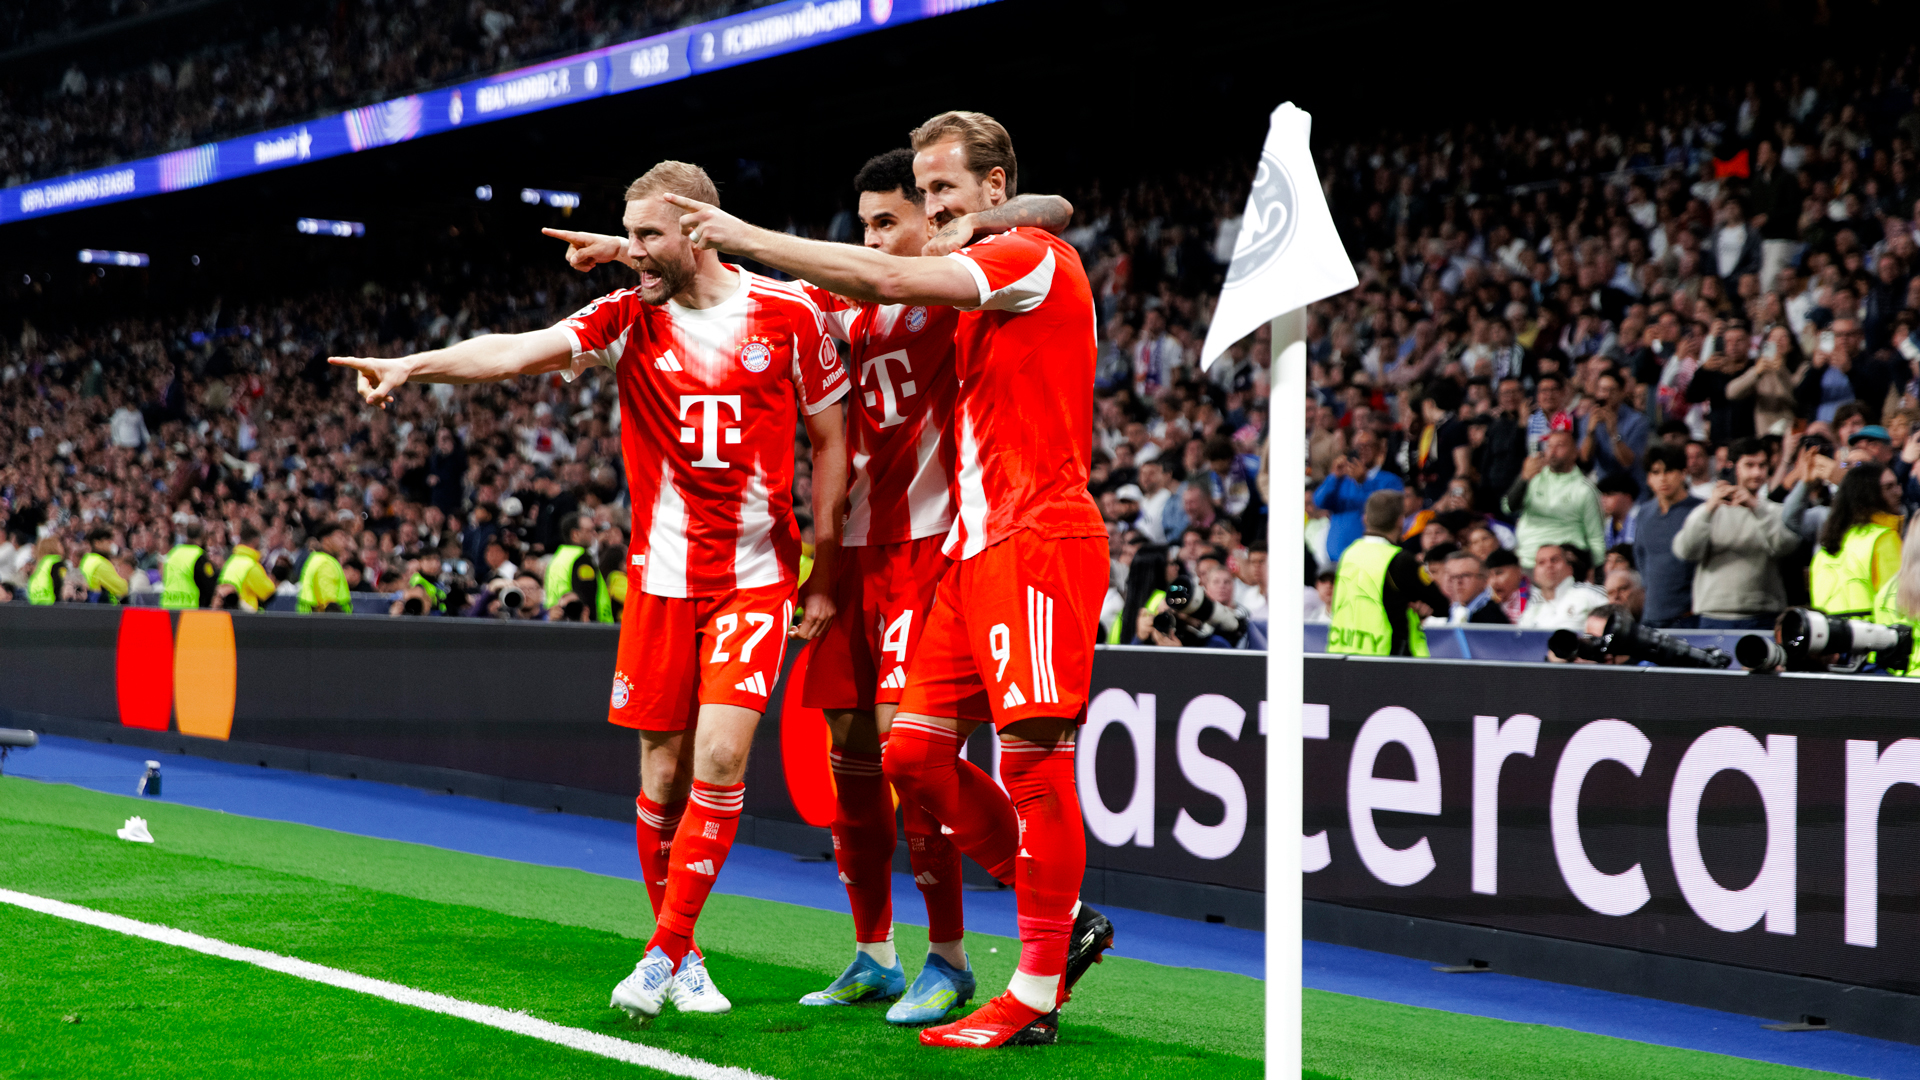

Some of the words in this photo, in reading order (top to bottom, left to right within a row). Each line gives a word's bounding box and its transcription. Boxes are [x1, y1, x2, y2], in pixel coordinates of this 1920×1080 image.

[701, 32, 715, 63] 2
[722, 25, 742, 56] FC
[741, 12, 793, 52] BAYERN
[792, 0, 861, 39] MÜNCHEN
[476, 83, 506, 114] REAL
[503, 73, 549, 108] MADRID
[584, 61, 598, 90] 0
[21, 188, 45, 213] UEFA
[44, 176, 99, 209] CHAMPIONS
[98, 168, 136, 199] LEAGUE
[709, 612, 775, 664] 27
[989, 622, 1011, 683] 9
[702, 831, 717, 840] MIA
